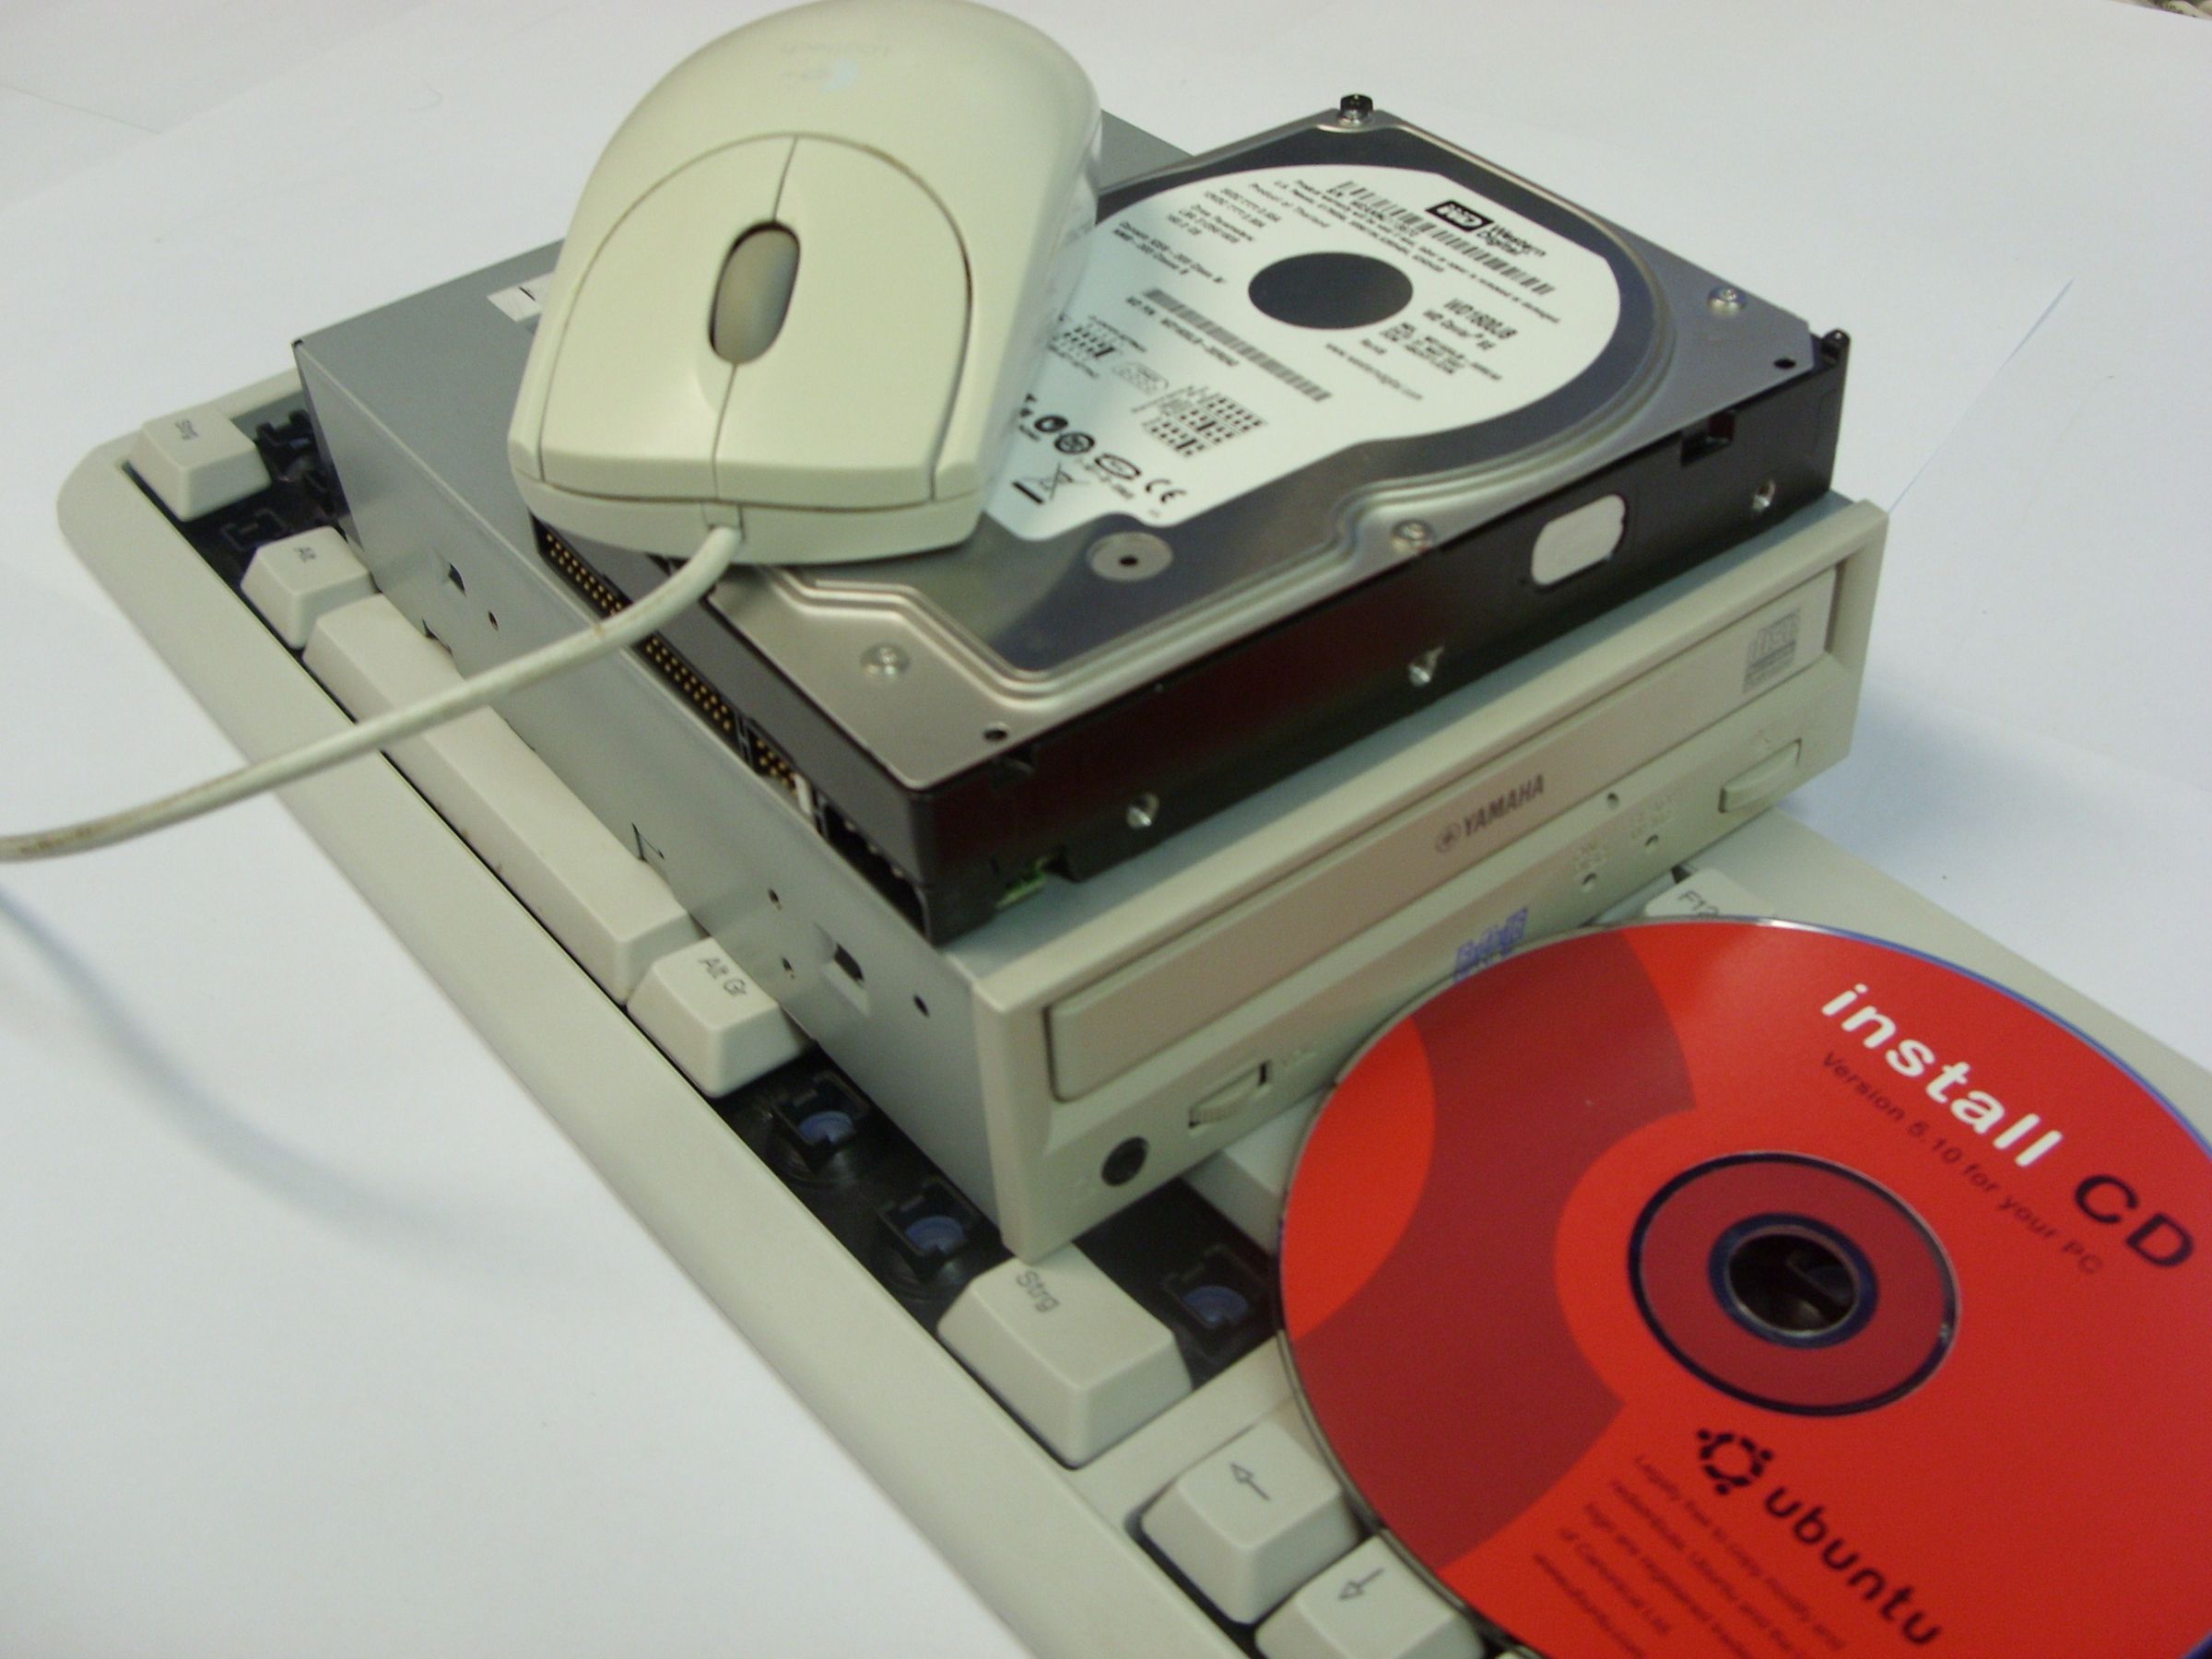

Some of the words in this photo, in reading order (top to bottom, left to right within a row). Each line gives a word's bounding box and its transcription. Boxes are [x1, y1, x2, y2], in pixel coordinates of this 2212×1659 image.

[1464, 773, 1545, 837] YAMAHA
[698, 958, 730, 981] Alt
[723, 979, 747, 996] Gr
[1821, 982, 2064, 1168] install
[2074, 1173, 2194, 1268] CD
[1822, 1051, 1906, 1124] Version
[1962, 1161, 2001, 1194] for
[1998, 1196, 2058, 1241] your
[2062, 1239, 2104, 1276] PC
[1016, 1271, 1061, 1312] Strg
[1763, 1486, 1942, 1647] ubuntu
